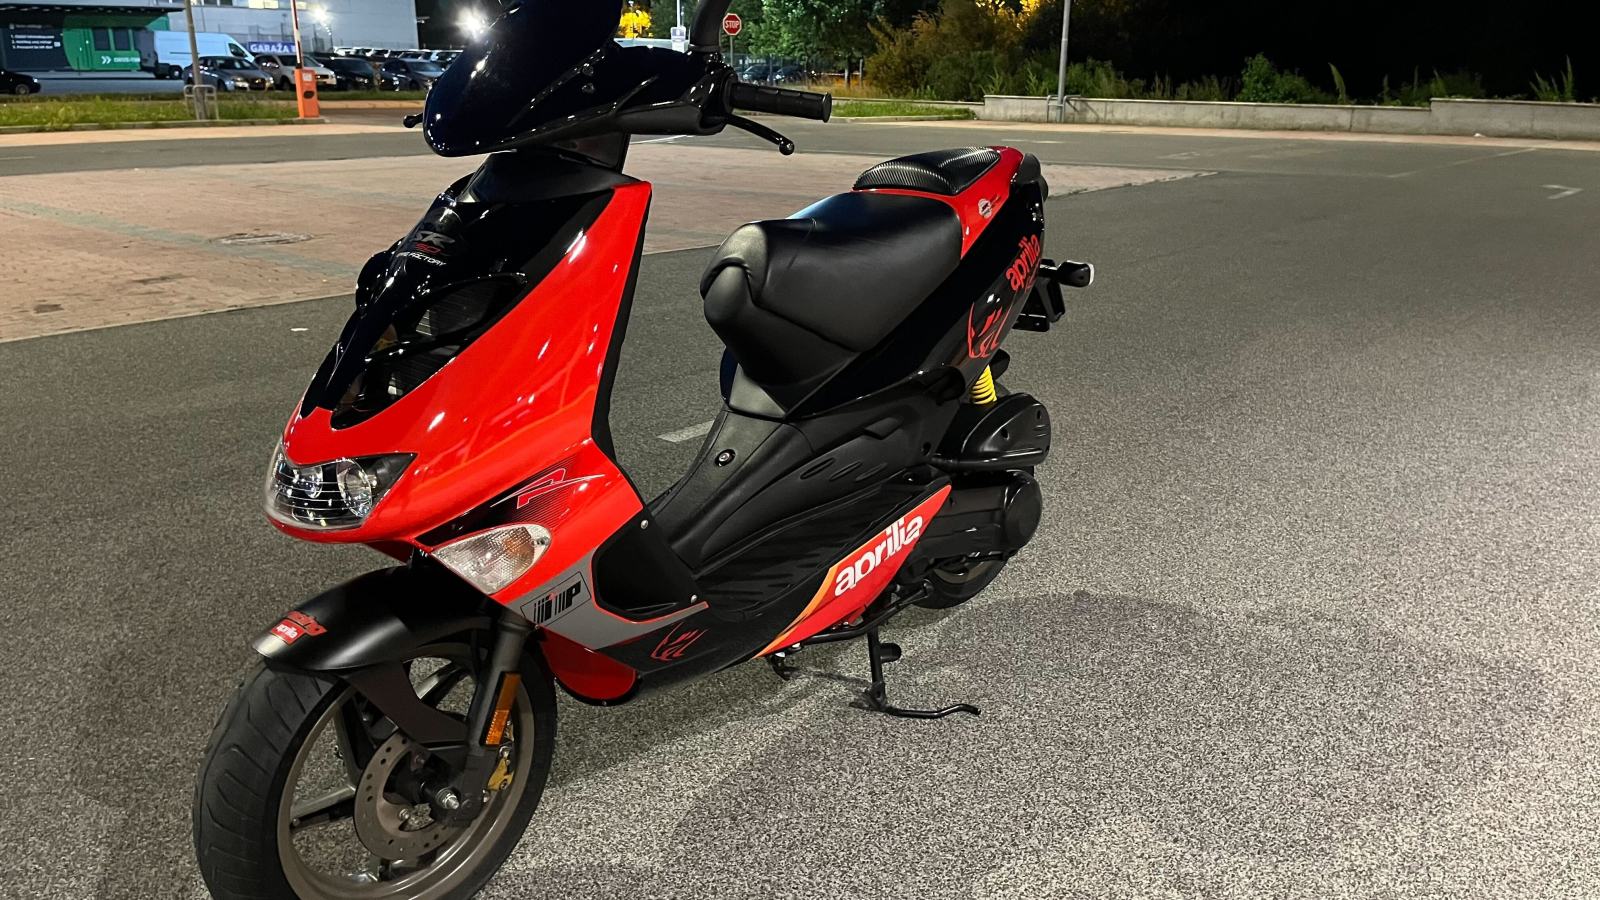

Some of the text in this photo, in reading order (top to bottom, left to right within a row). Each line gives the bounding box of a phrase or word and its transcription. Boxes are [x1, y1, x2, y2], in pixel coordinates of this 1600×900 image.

[725, 20, 740, 29] STOP
[250, 42, 290, 53] GARAŽA
[1005, 233, 1041, 292] aprilia
[834, 515, 923, 597] aprilia
